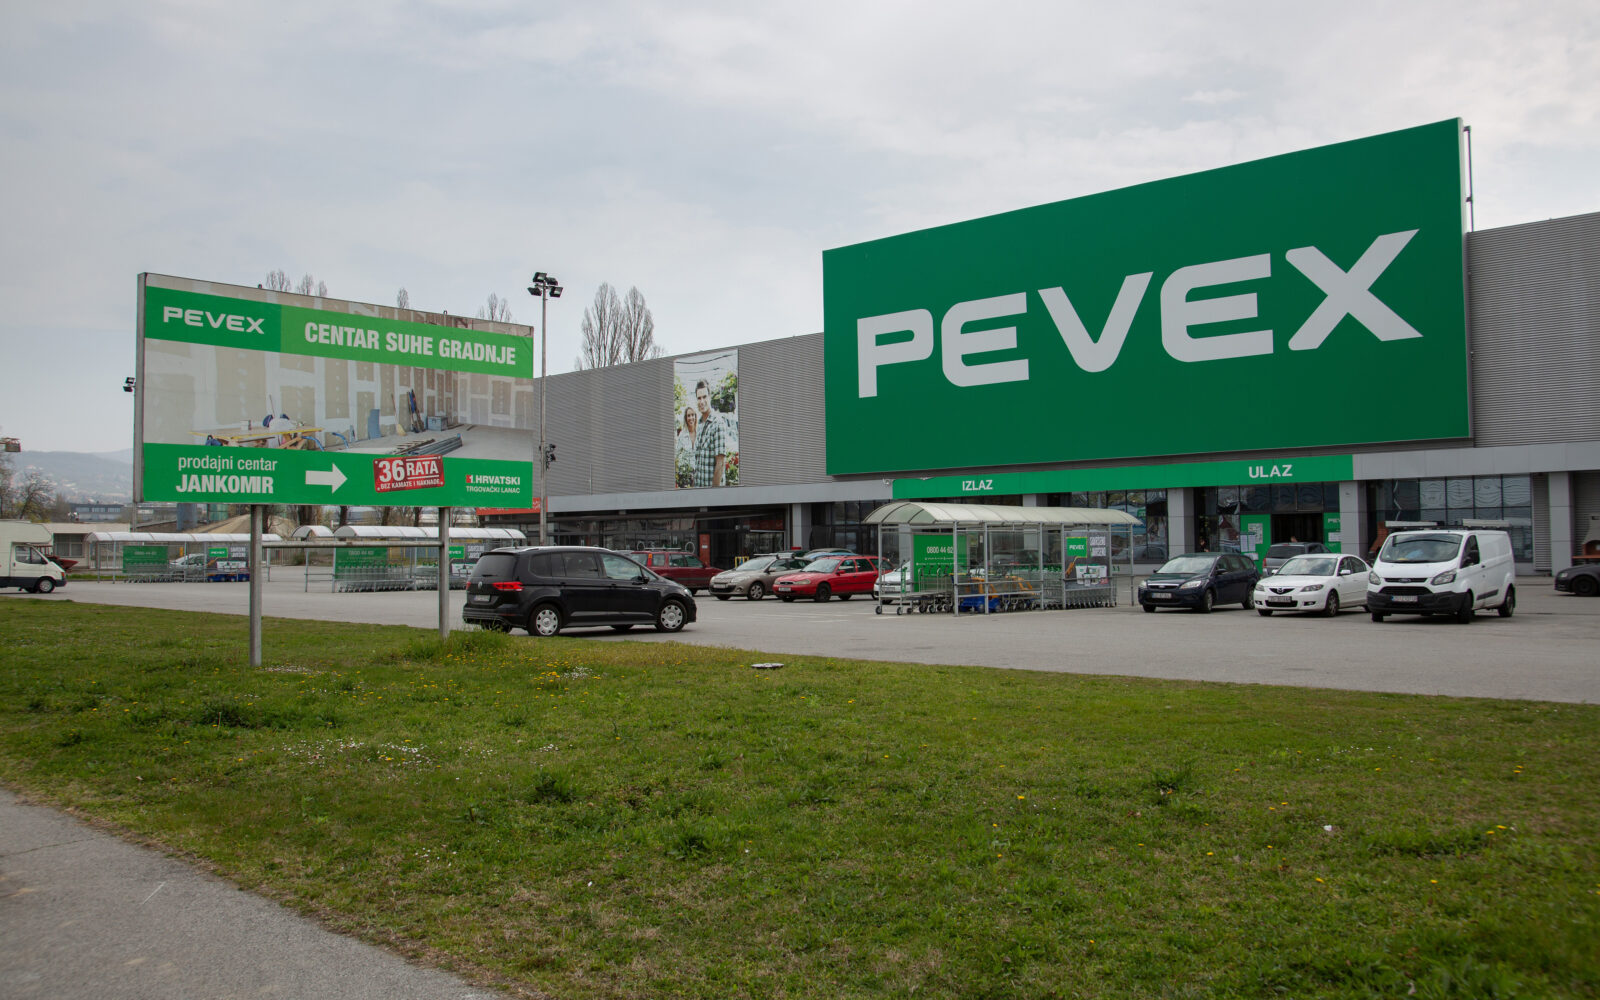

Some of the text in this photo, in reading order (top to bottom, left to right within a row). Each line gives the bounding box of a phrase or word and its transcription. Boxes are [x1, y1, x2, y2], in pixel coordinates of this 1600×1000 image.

[163, 306, 265, 335] PEVEX
[857, 229, 1423, 398] PEVEX
[304, 322, 516, 365] CENTAR SUHE GRADNJE
[178, 455, 278, 472] prodajni centar
[378, 459, 439, 482] 36 RATA
[1248, 464, 1293, 479] ULAZ
[176, 474, 274, 494] JANKOMIR
[392, 480, 412, 488] KAMATE
[416, 478, 440, 486] NAKNADE
[466, 485, 500, 493] TRGOVAČKI
[962, 479, 993, 491] IZLAZ
